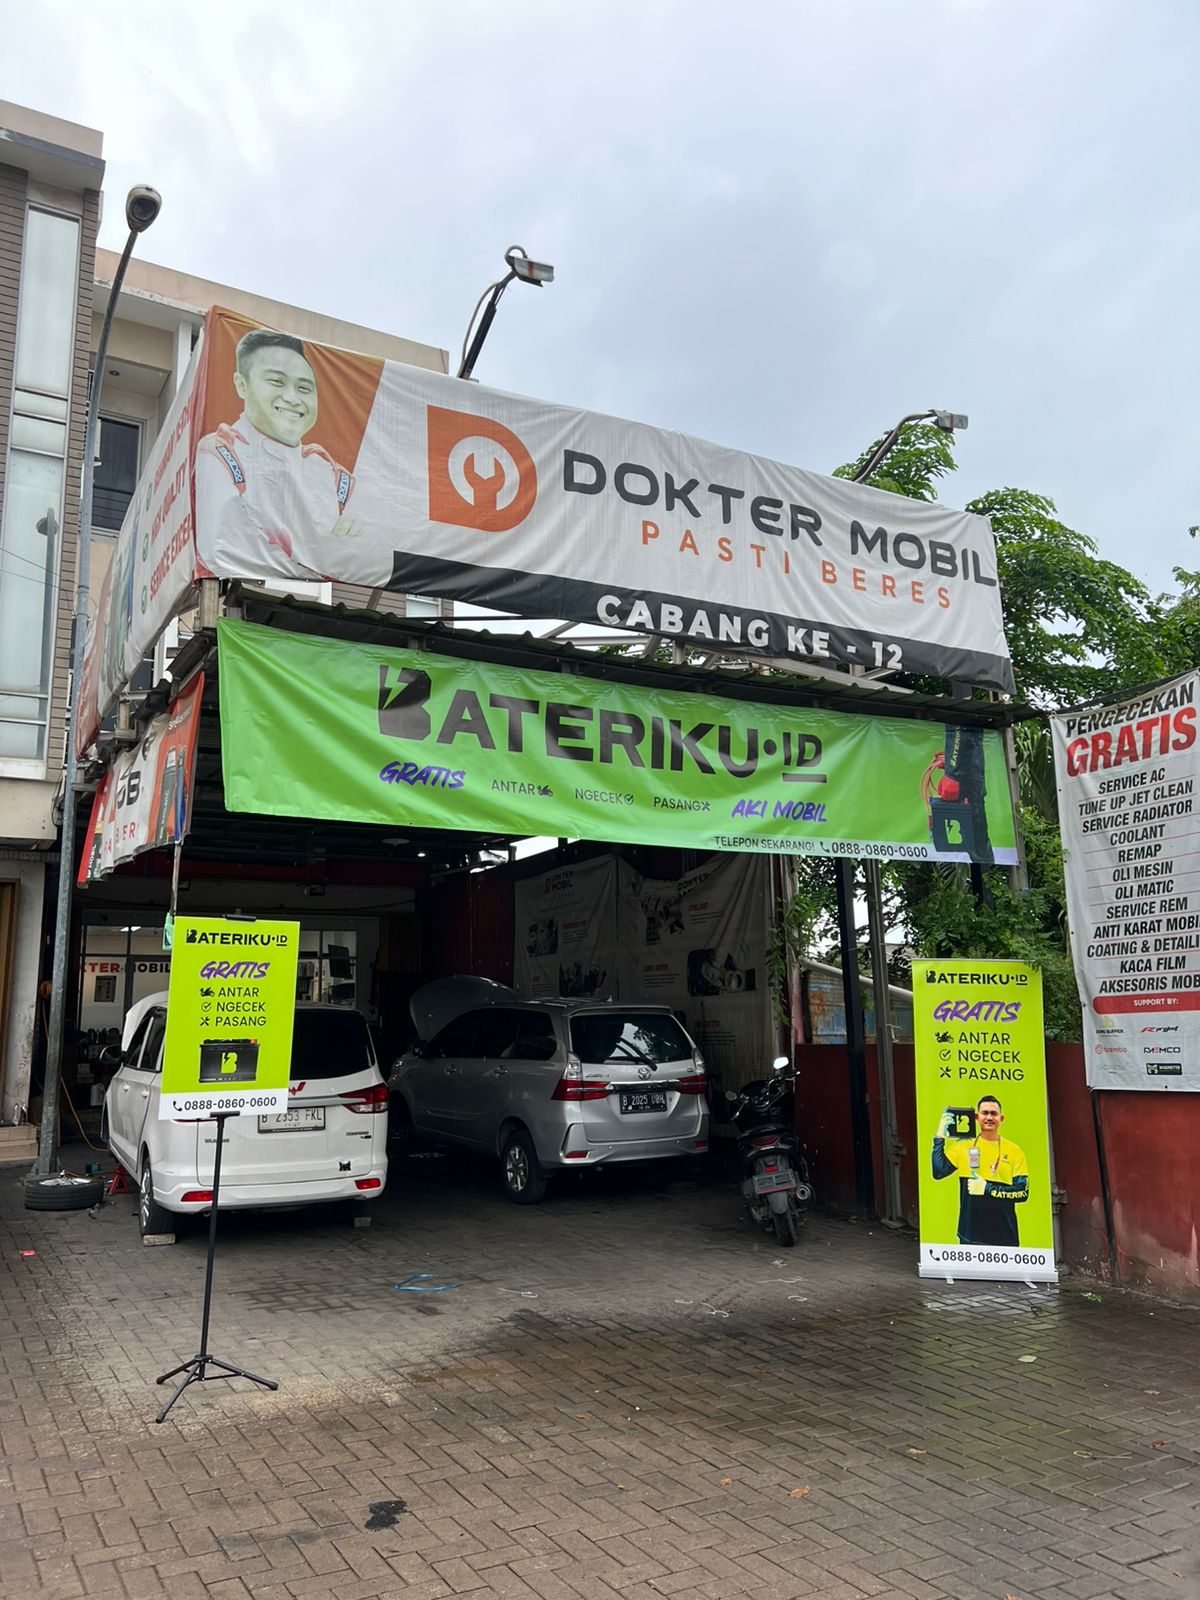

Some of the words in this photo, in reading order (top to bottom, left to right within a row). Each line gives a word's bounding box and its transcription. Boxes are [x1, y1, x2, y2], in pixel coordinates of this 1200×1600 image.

[562, 448, 823, 547] DOKTER
[850, 520, 997, 588] MOBIL
[641, 520, 790, 575] PASTI
[821, 560, 951, 609] BERES
[596, 594, 771, 648] CABANG
[786, 624, 830, 659] KE
[870, 641, 903, 671] 12
[1065, 681, 1195, 737] PENGECEKAN
[1066, 706, 1197, 777] GRATIS
[1099, 772, 1147, 795] SERVICE
[1149, 767, 1165, 783] AC
[378, 761, 466, 789] GRATIS
[491, 779, 536, 796] ANTAR
[575, 788, 623, 804] NGECEK
[654, 797, 700, 812] PASANG
[731, 798, 768, 819] AKI
[772, 801, 828, 823] MOBIL
[1079, 799, 1106, 816] TUNE
[1110, 796, 1126, 810] UP
[1129, 790, 1150, 806] JET
[1153, 780, 1193, 801] CLEAN
[1082, 813, 1129, 834] SERVICE
[1132, 799, 1193, 824] RADIATOR
[1110, 824, 1166, 846] COOLANT
[714, 835, 759, 850] TELEPON
[831, 841, 928, 858] 0888-0860-0600
[1118, 844, 1162, 863] REMAP
[1113, 868, 1131, 882] OLI
[1134, 861, 1173, 879] MESIN
[1115, 886, 1133, 900] OLI
[1137, 880, 1174, 899] MATIC
[1106, 903, 1156, 919] SERVICE
[1159, 896, 1188, 912] REM
[1093, 925, 1121, 940] ANTI
[1123, 919, 1163, 938] KARAT
[1166, 915, 1200, 932] MOBI
[1087, 940, 1138, 958] COATING
[1140, 939, 1151, 953] &
[199, 961, 270, 980] GRATIS
[1120, 958, 1152, 974] KACA
[1156, 955, 1187, 971] FILM
[217, 987, 259, 998] ANTAR
[1099, 976, 1168, 994] AKSESORIS
[216, 1001, 265, 1013] NGECEK
[933, 1000, 1022, 1023] GRATIS
[1133, 998, 1166, 1007] SUPPORT
[215, 1016, 267, 1027] PASANG
[958, 1032, 1011, 1045] ANTAR
[958, 1050, 1021, 1063] NGECEK
[959, 1067, 1025, 1081] PASANG
[184, 1096, 277, 1110] 0888-0860-0600
[631, 1095, 648, 1105] 2025
[305, 1109, 322, 1121] FKL
[941, 1250, 1046, 1266] 0888-0860-0600
